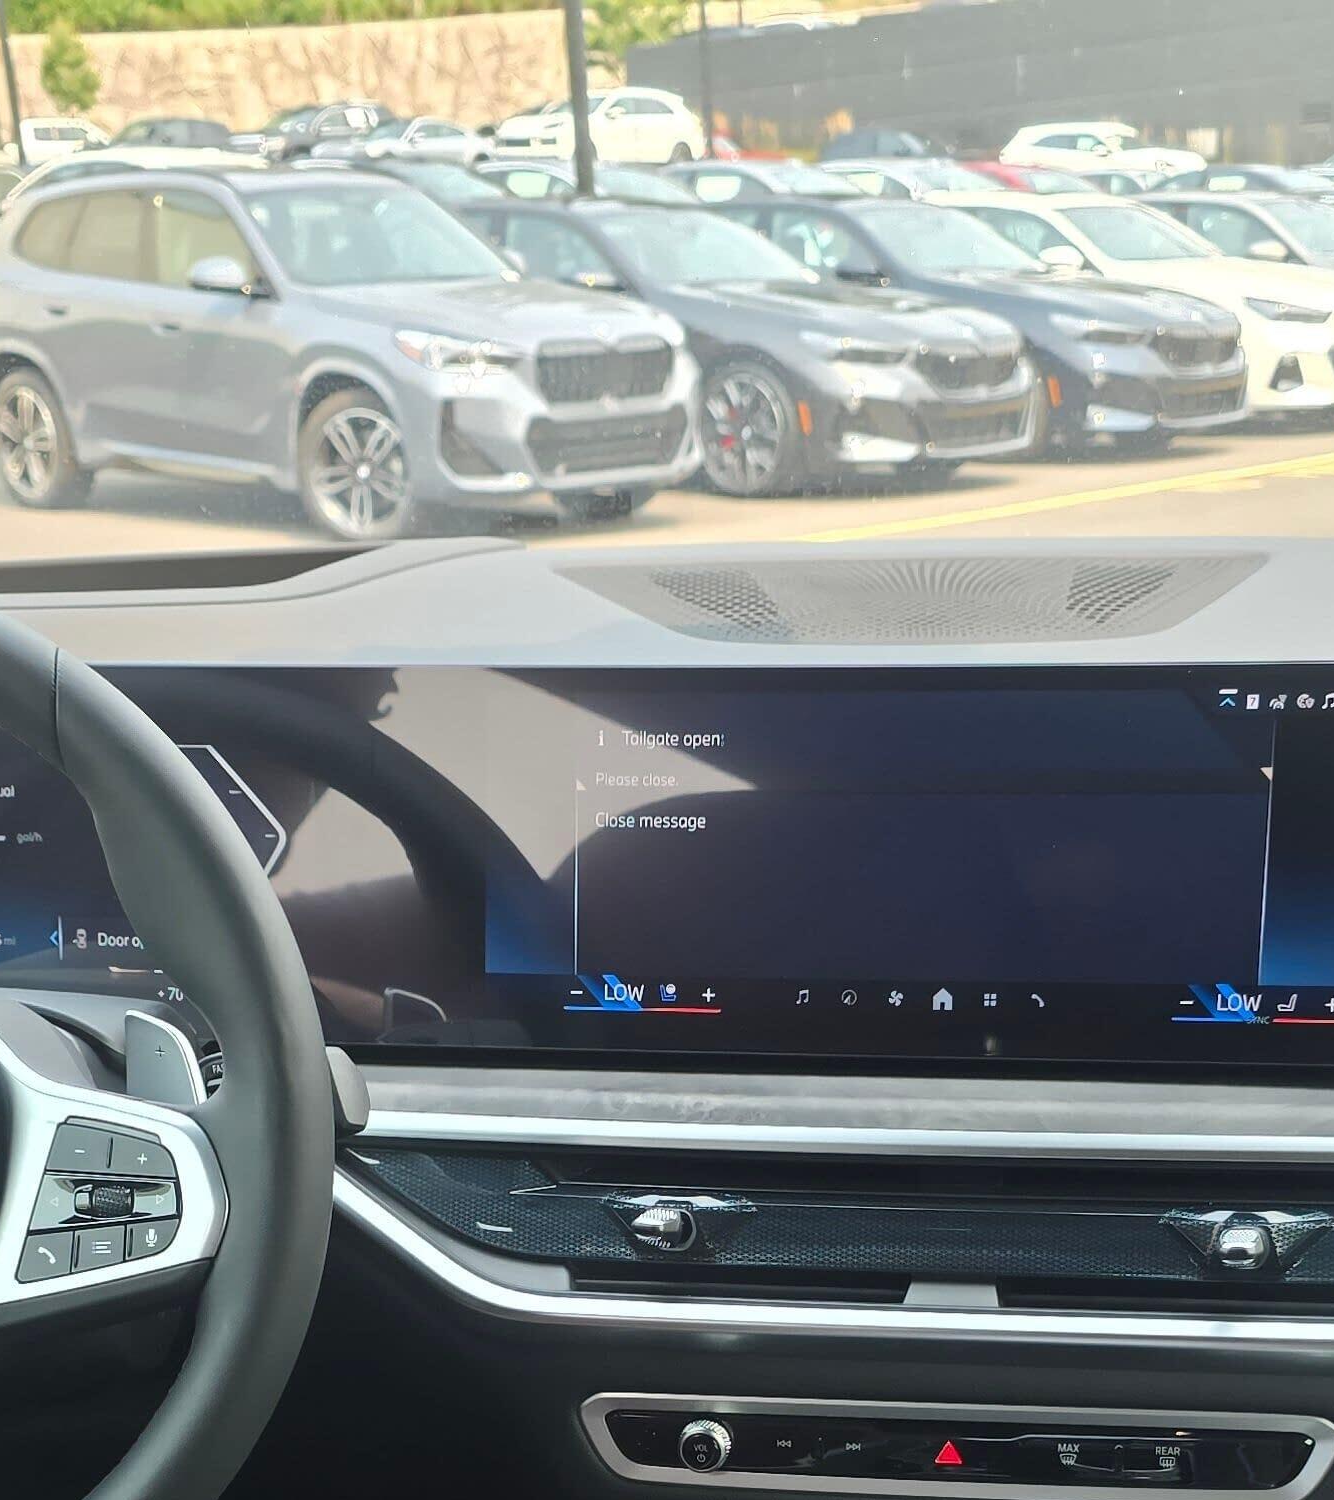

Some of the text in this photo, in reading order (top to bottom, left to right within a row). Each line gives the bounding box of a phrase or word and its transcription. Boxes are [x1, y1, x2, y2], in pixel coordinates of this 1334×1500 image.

[621, 730, 679, 748] Tailgate
[595, 772, 639, 787] Please
[595, 811, 706, 831] Close message
[97, 932, 130, 948] Door
[604, 983, 645, 1002] LOW
[1216, 993, 1262, 1012] LOW
[1057, 1443, 1080, 1453] MAX
[1155, 1446, 1181, 1456] REAR
